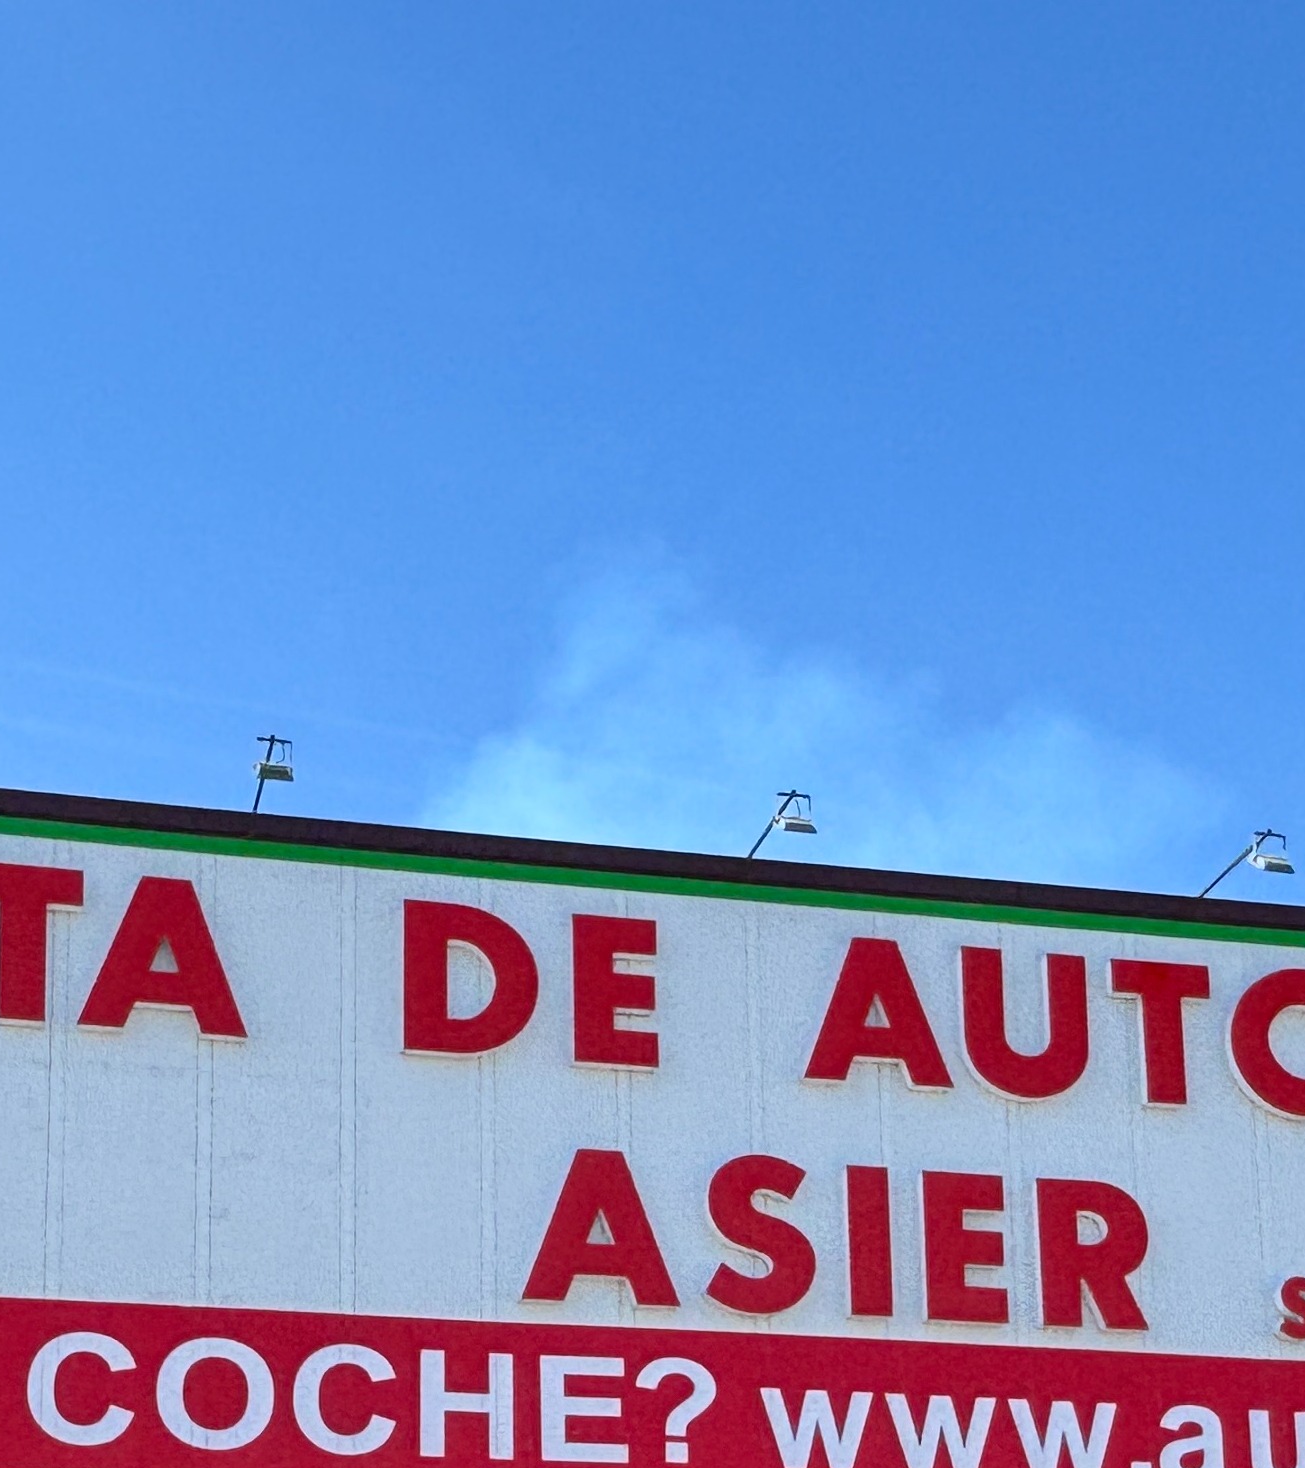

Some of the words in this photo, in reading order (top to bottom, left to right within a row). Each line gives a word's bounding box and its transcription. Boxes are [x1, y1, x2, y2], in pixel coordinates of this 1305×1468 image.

[403, 899, 660, 1068] DE
[523, 1148, 1149, 1332] ASIER
[28, 1332, 716, 1463] COCHE?
